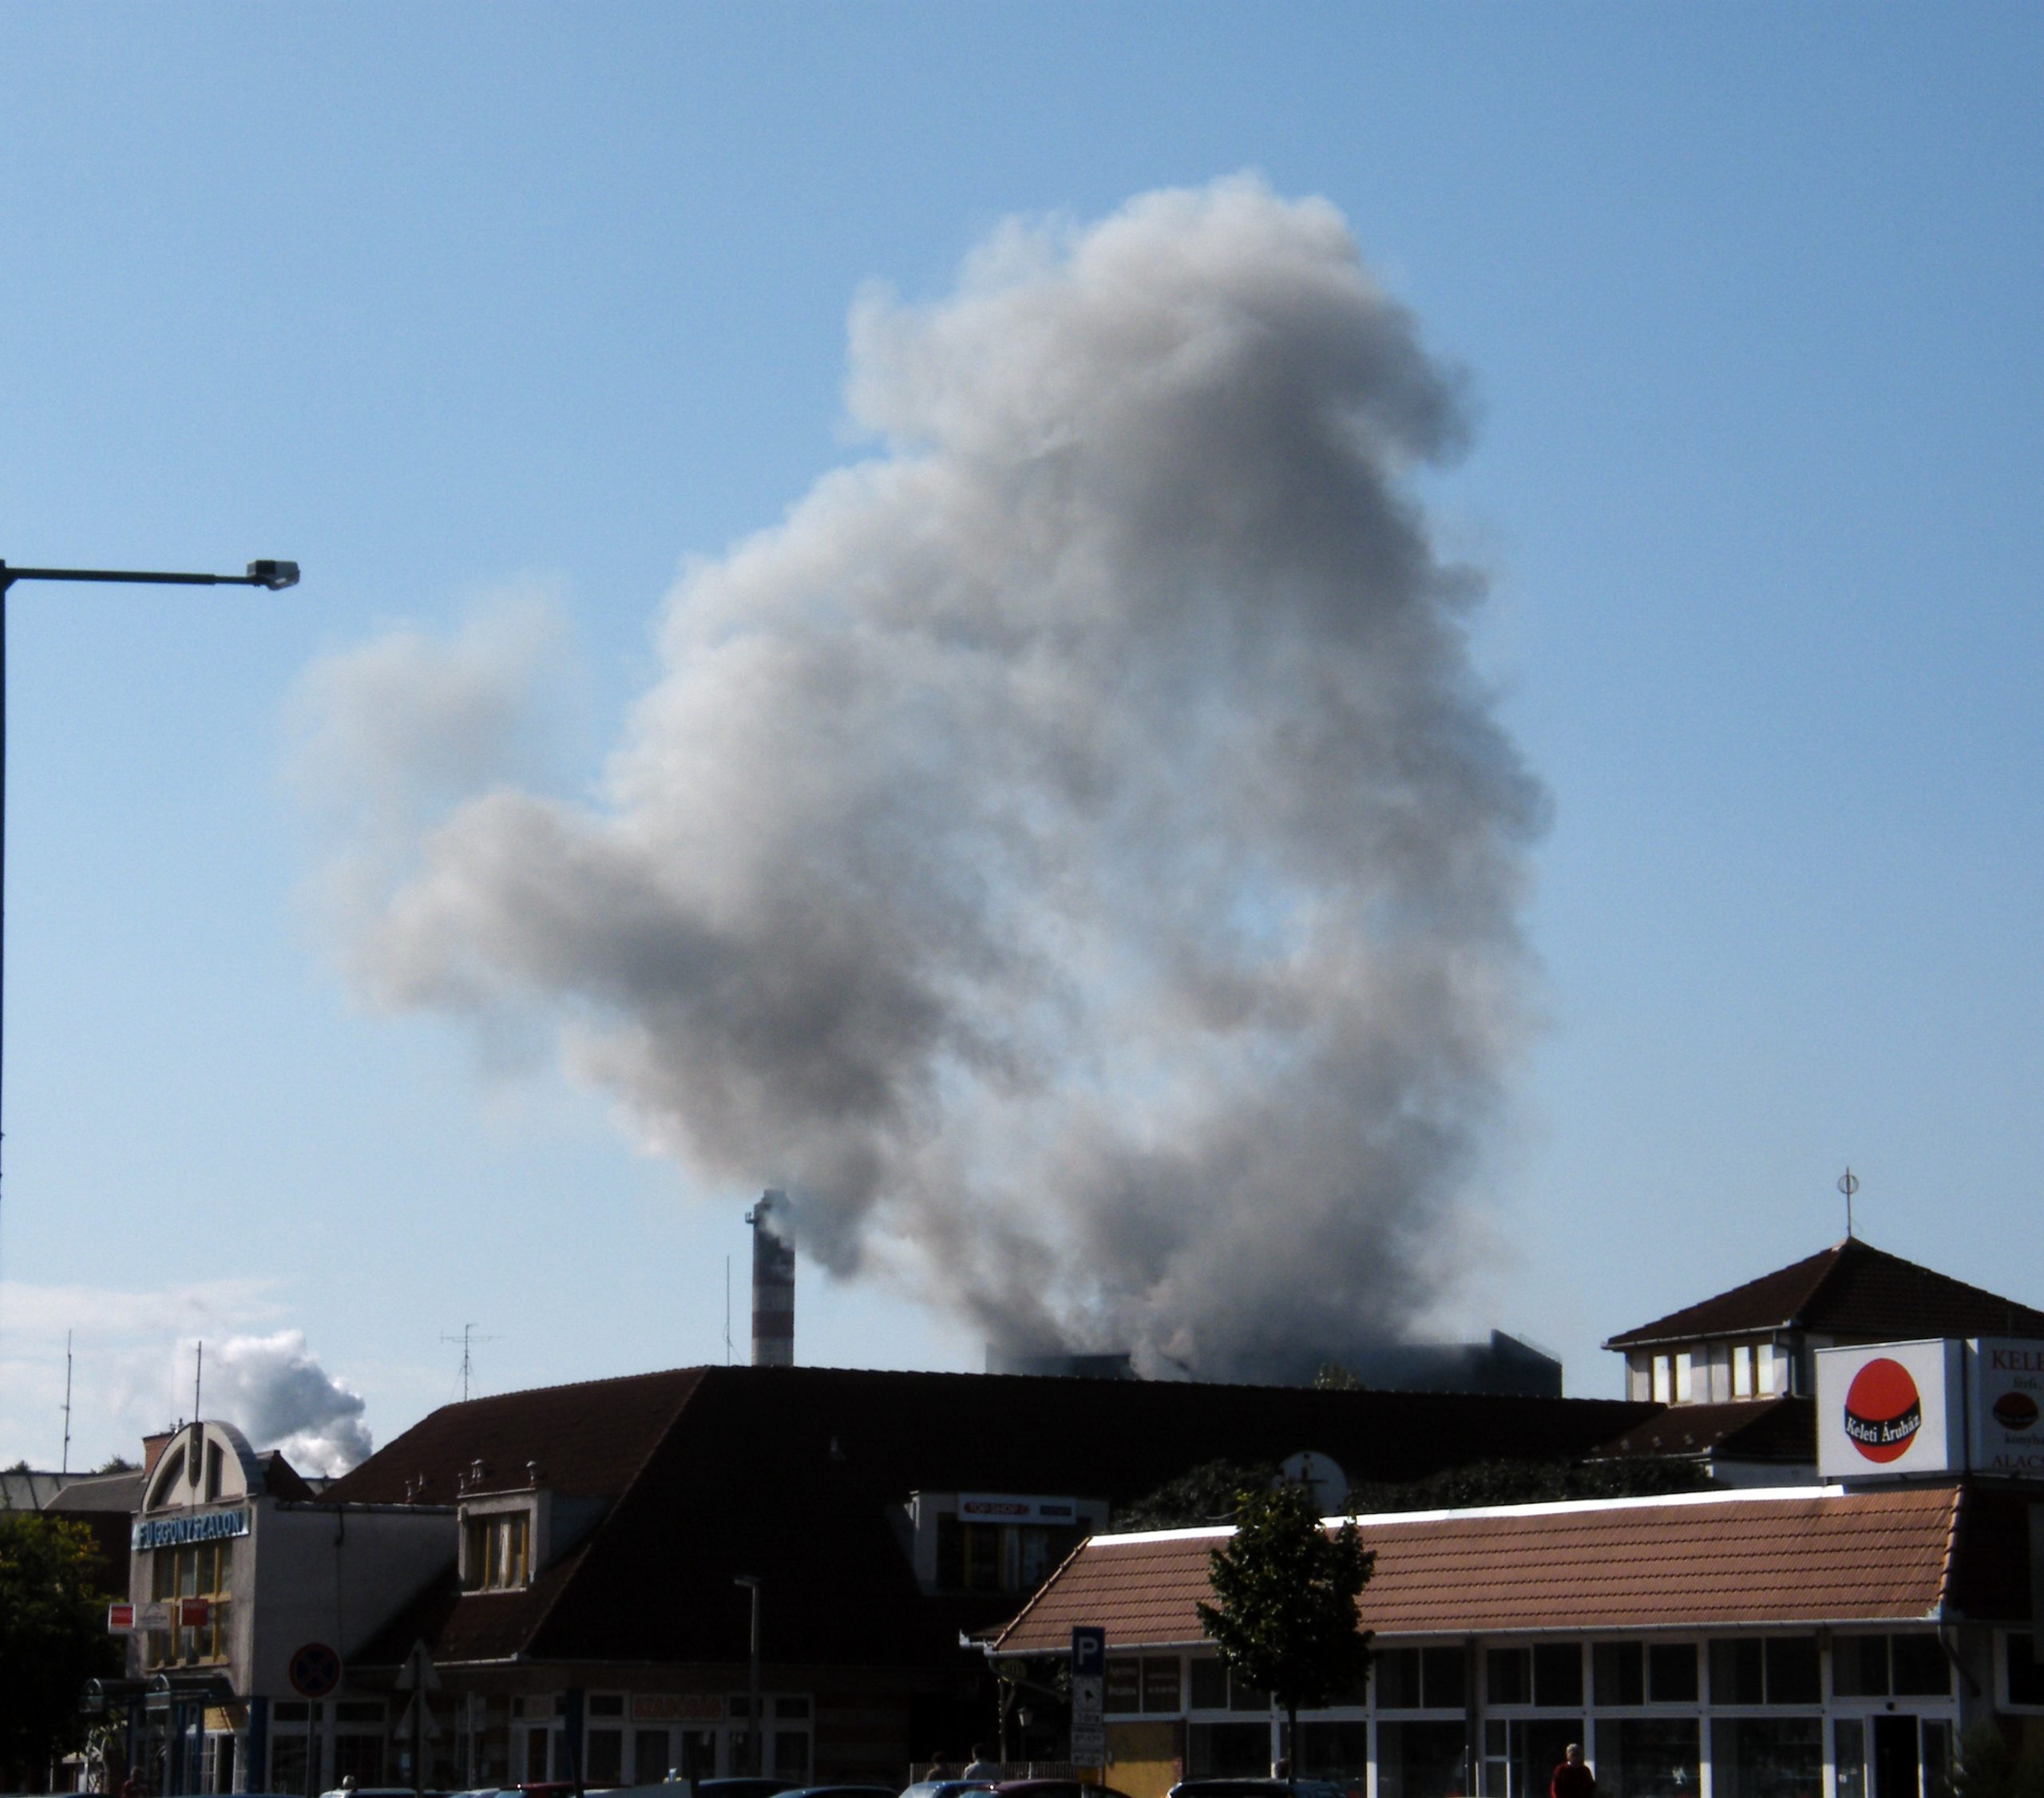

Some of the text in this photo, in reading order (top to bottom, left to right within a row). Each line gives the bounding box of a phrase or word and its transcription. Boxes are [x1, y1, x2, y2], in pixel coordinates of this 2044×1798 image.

[1846, 1414, 1919, 1443] Keleti Áruház
[1078, 1636, 1099, 1665] P
